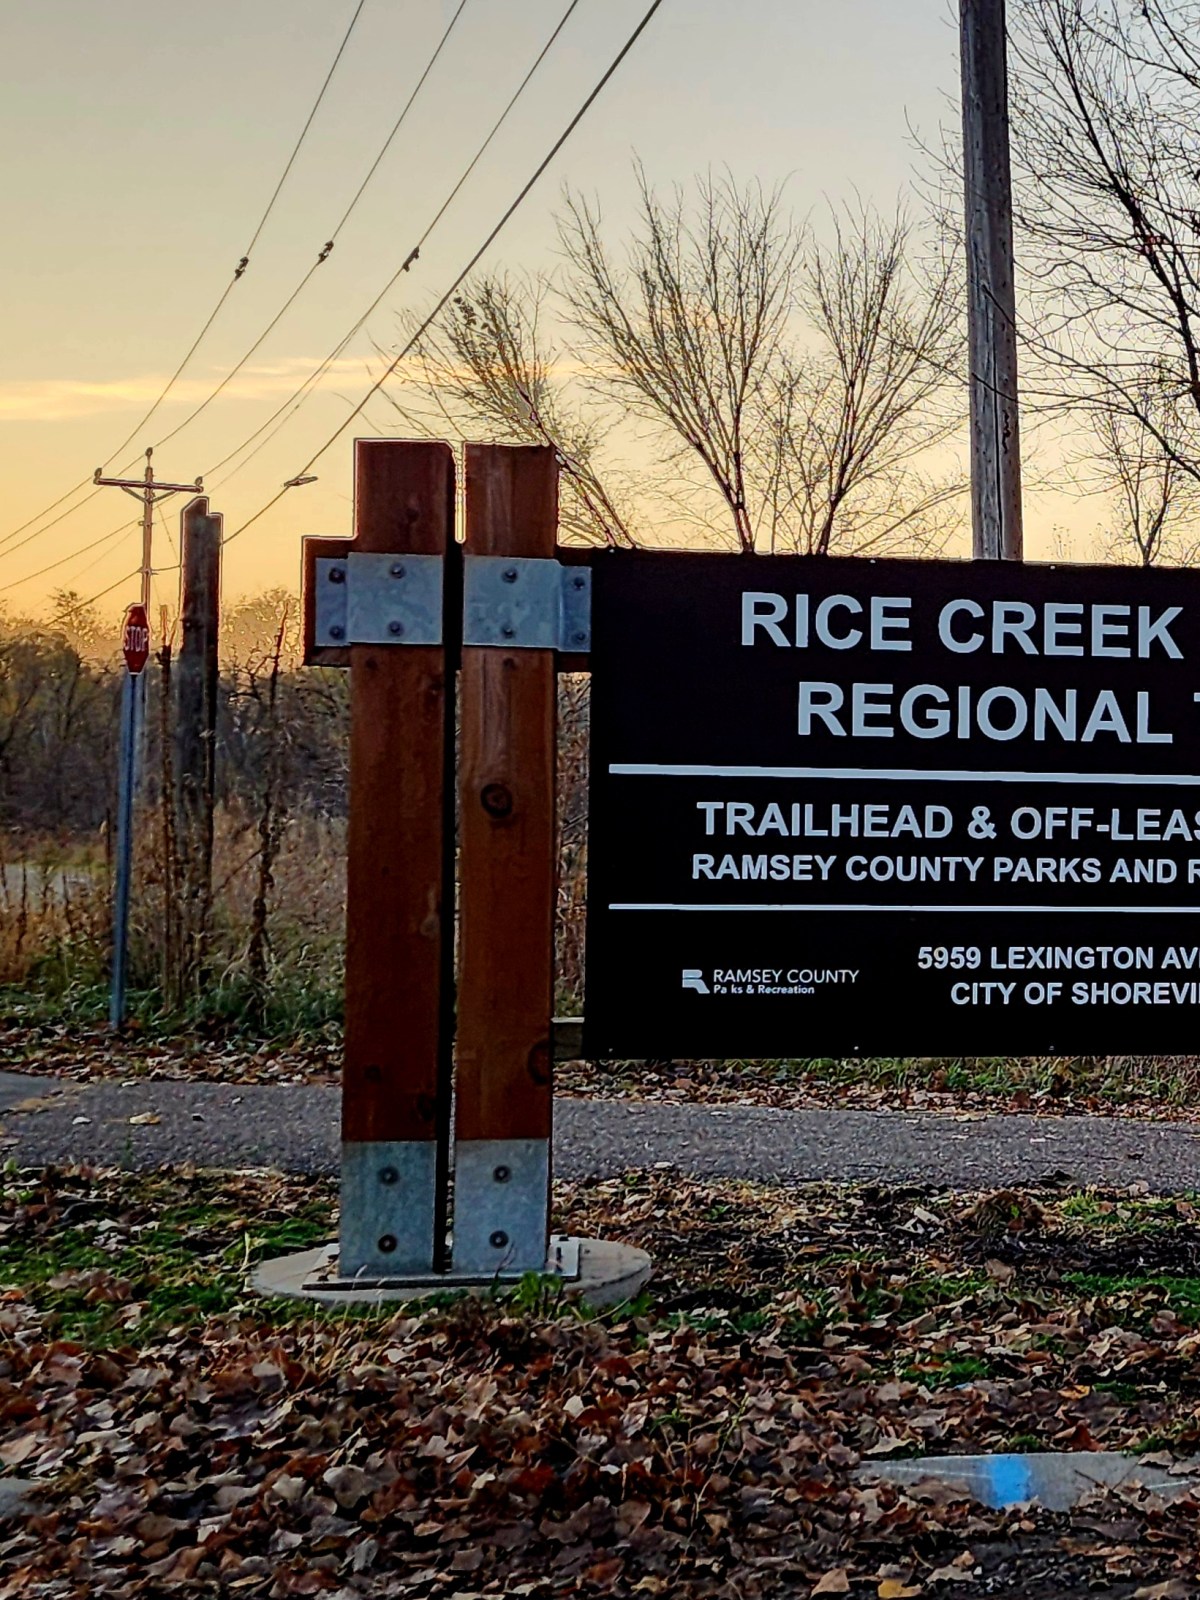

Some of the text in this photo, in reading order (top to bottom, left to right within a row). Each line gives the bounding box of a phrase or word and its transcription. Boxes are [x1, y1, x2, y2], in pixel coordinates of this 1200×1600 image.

[742, 592, 912, 650] RICE
[939, 599, 1183, 658] CREEK
[124, 626, 148, 652] STOP
[799, 682, 1172, 743] REGIONAL
[697, 802, 952, 838] TRAILHEAD
[968, 806, 997, 839] &
[692, 854, 836, 880] RAMSEY
[846, 856, 984, 881] COUNTY
[994, 857, 1101, 882] PARKS
[1110, 859, 1177, 883] AND
[918, 947, 980, 969] 5959
[991, 947, 1153, 969] LEXINGTON
[713, 984, 815, 994] Paks & Recreation
[714, 970, 859, 983] RAMSEY COUNTY
[951, 983, 1016, 1004] CITY
[1024, 983, 1062, 1004] OF
